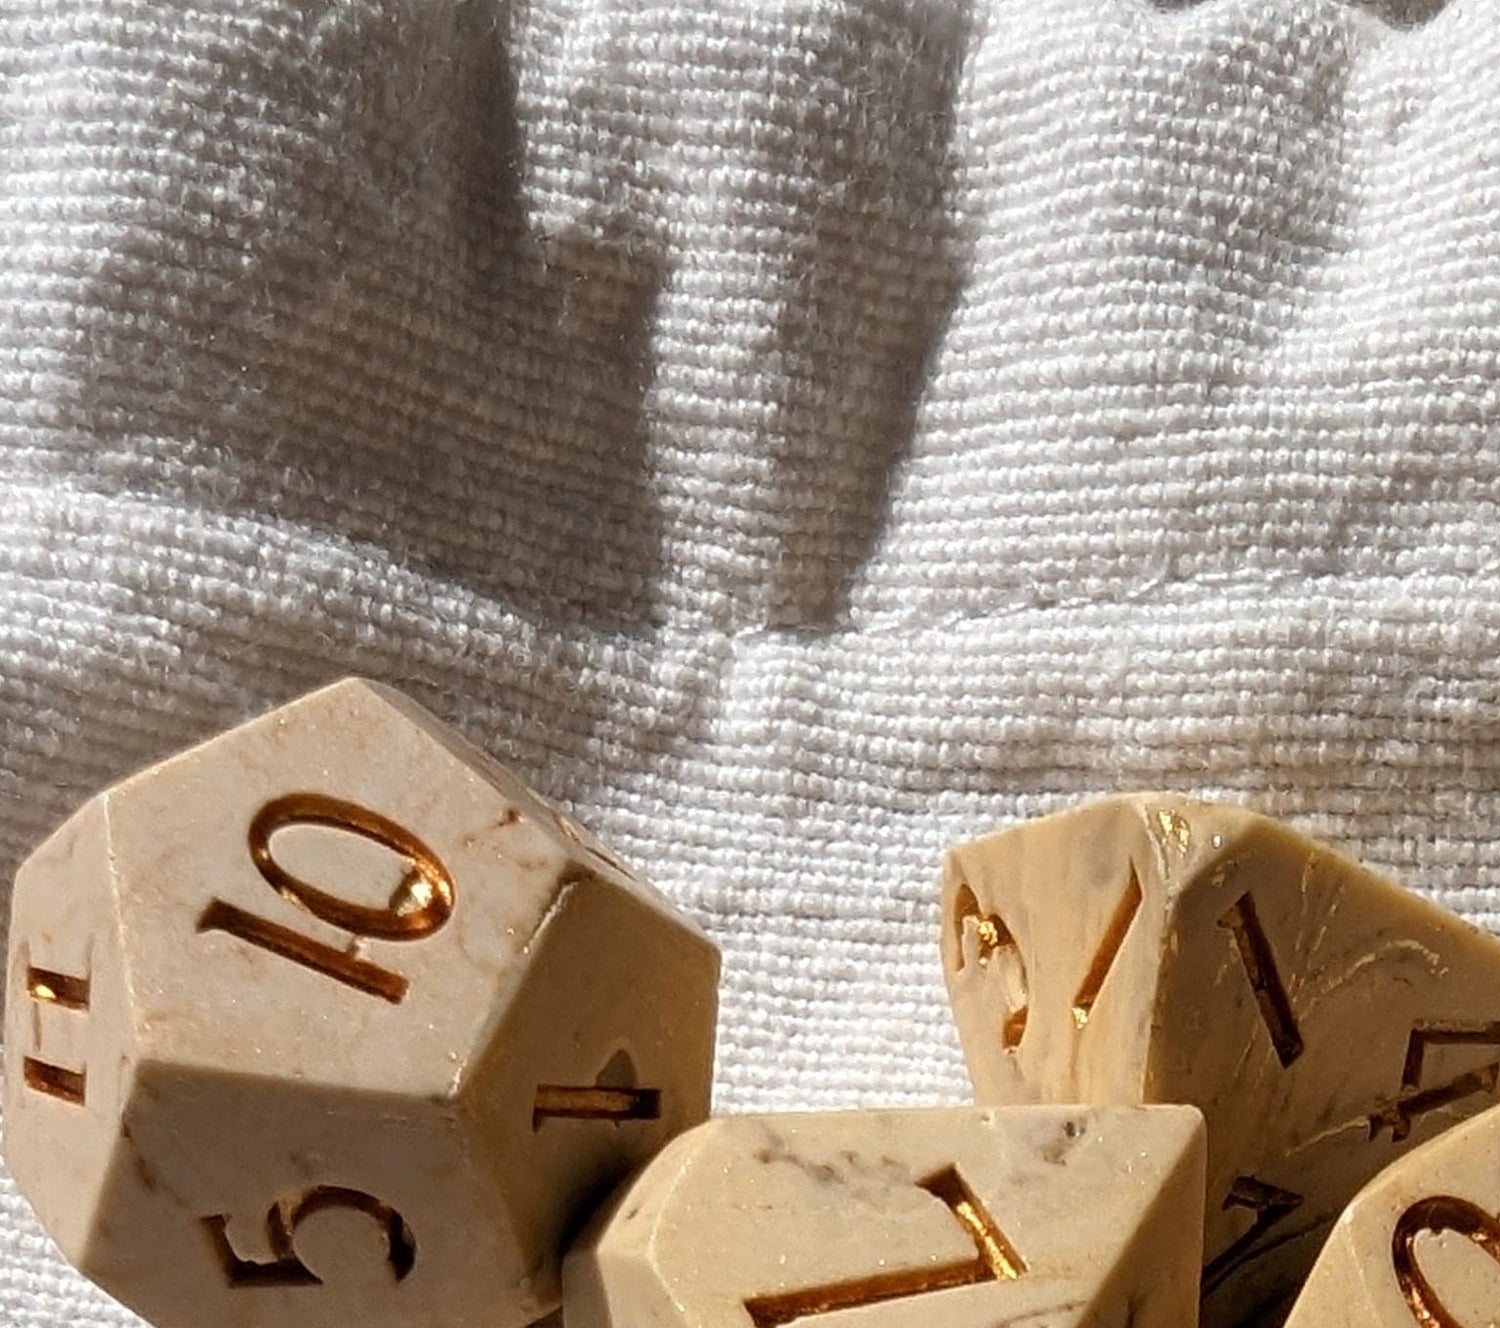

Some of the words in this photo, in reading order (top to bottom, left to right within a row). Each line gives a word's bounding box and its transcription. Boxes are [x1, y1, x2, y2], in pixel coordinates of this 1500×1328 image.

[196, 792, 456, 1006] 10
[1216, 891, 1305, 1069] 1
[203, 1184, 417, 1290] 5
